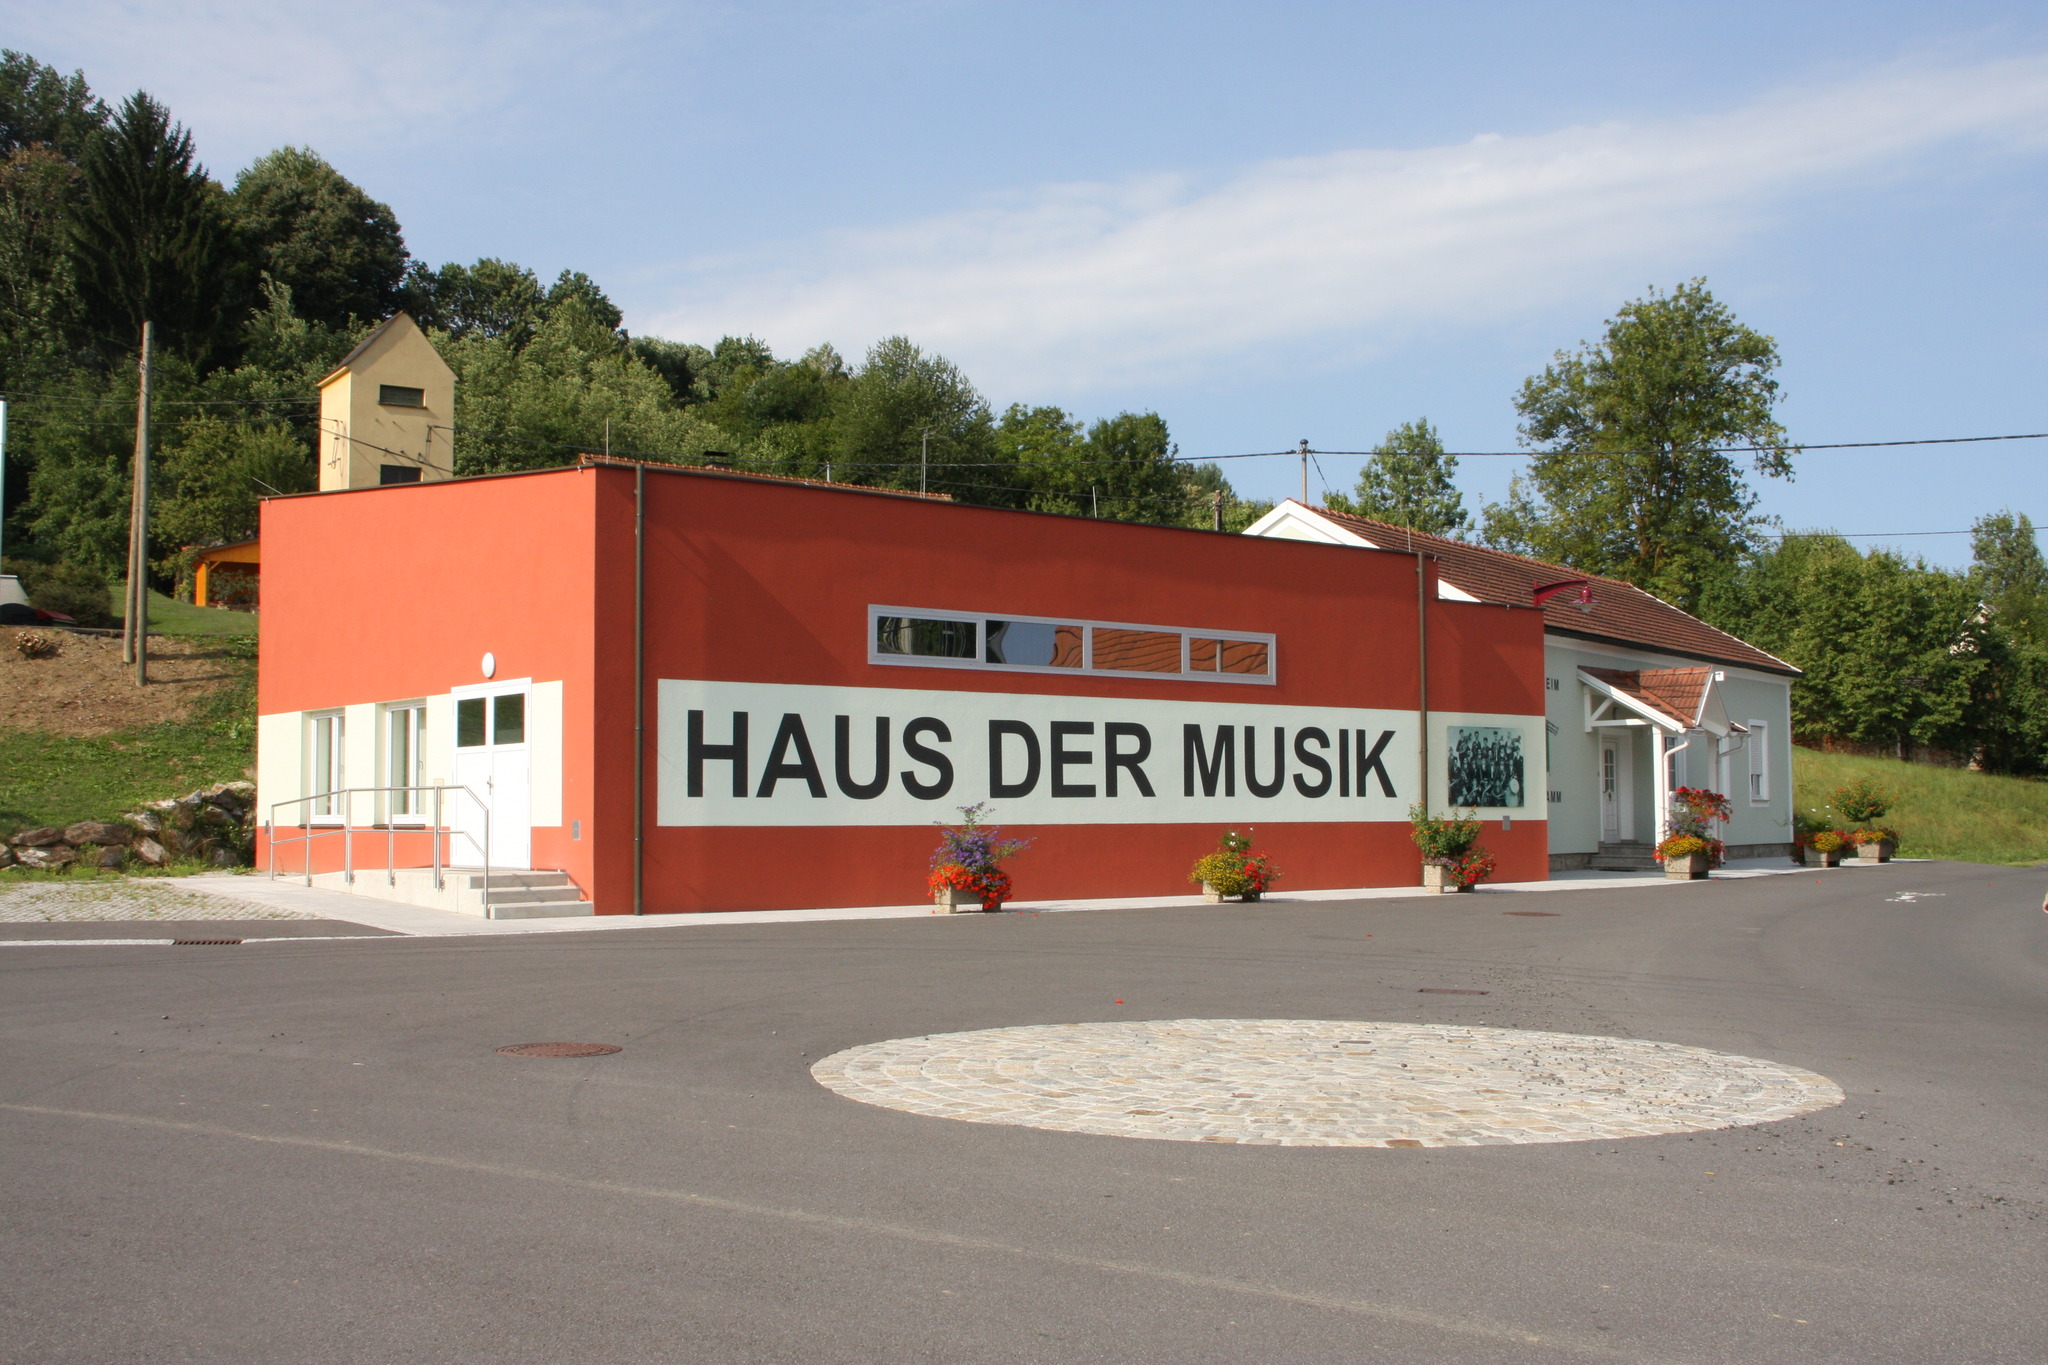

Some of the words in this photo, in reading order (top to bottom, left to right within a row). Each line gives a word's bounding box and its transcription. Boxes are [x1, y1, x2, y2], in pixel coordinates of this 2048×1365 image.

[687, 709, 954, 801] HAUS
[988, 719, 1156, 799] DER
[1183, 723, 1398, 799] MUSIK
